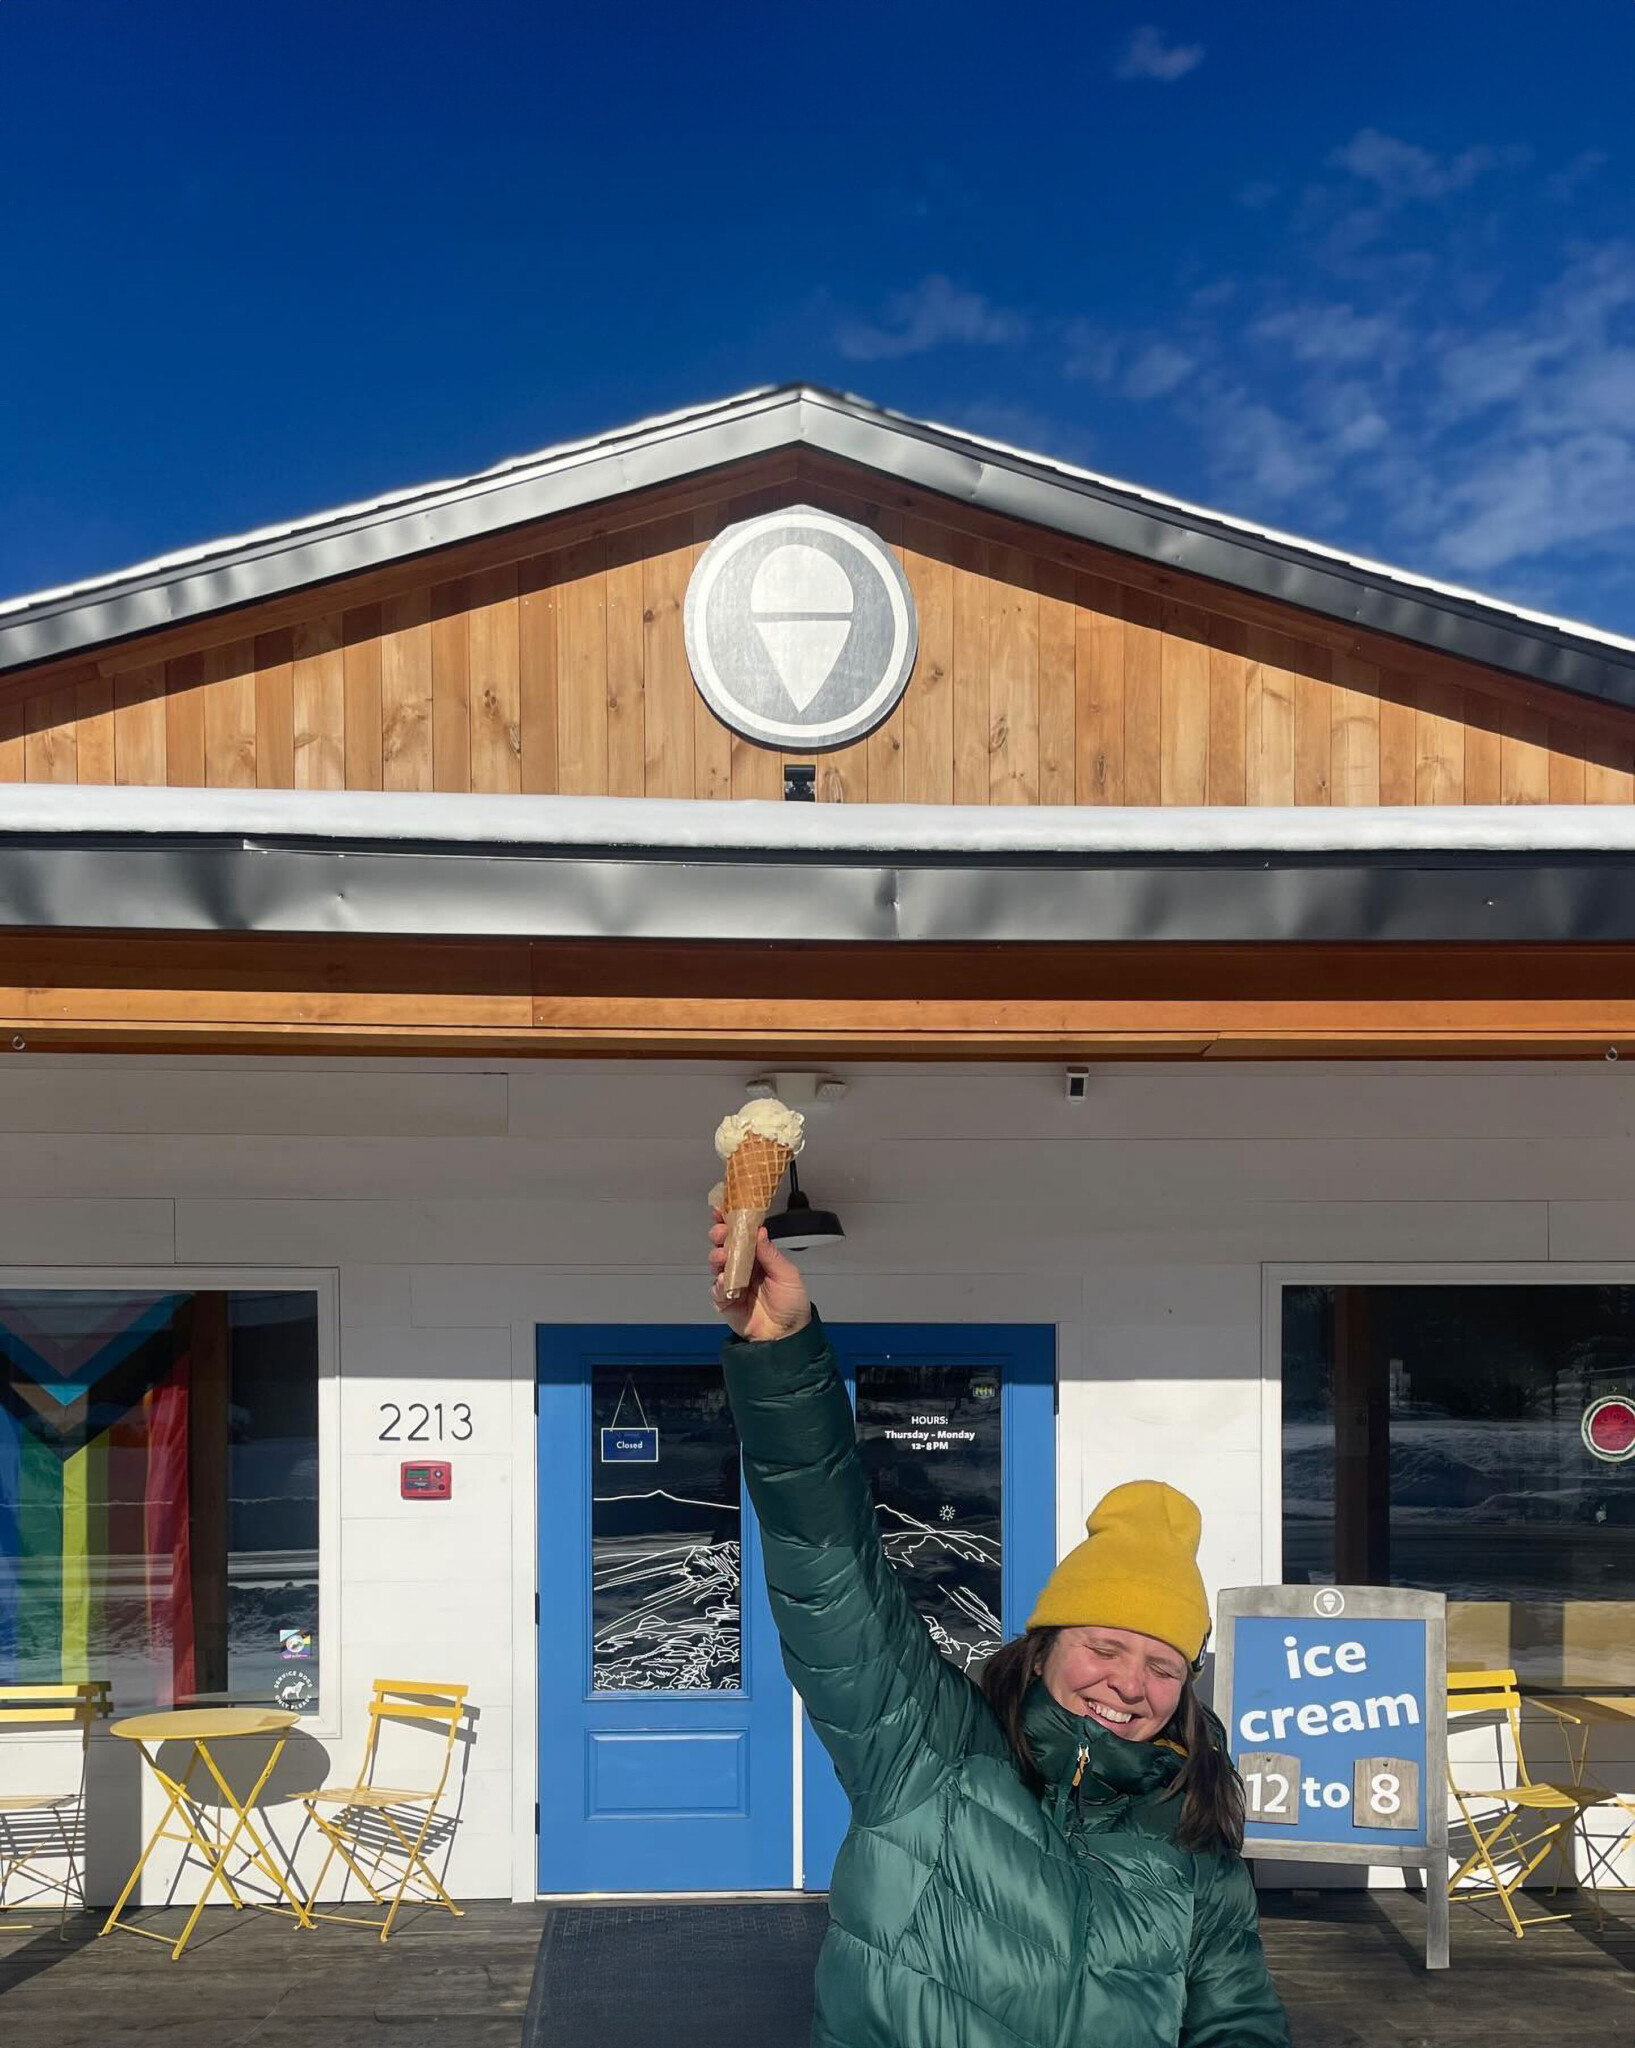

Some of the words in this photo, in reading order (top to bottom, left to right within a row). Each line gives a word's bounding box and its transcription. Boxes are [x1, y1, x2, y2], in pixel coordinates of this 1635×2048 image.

[378, 1403, 473, 1441] 2213
[911, 1415, 949, 1425] HOURS:
[884, 1430, 930, 1441] Thursday
[937, 1430, 976, 1441] Monday
[616, 1440, 643, 1449] Closed
[1283, 1635, 1368, 1680] ice
[274, 1671, 297, 1688] SERVICE
[299, 1672, 313, 1688] DOGS
[291, 1695, 312, 1709] PLEASE
[1239, 1692, 1420, 1742] cream
[1246, 1772, 1290, 1813] 12
[1302, 1777, 1350, 1808] to
[1370, 1773, 1401, 1814] 8
